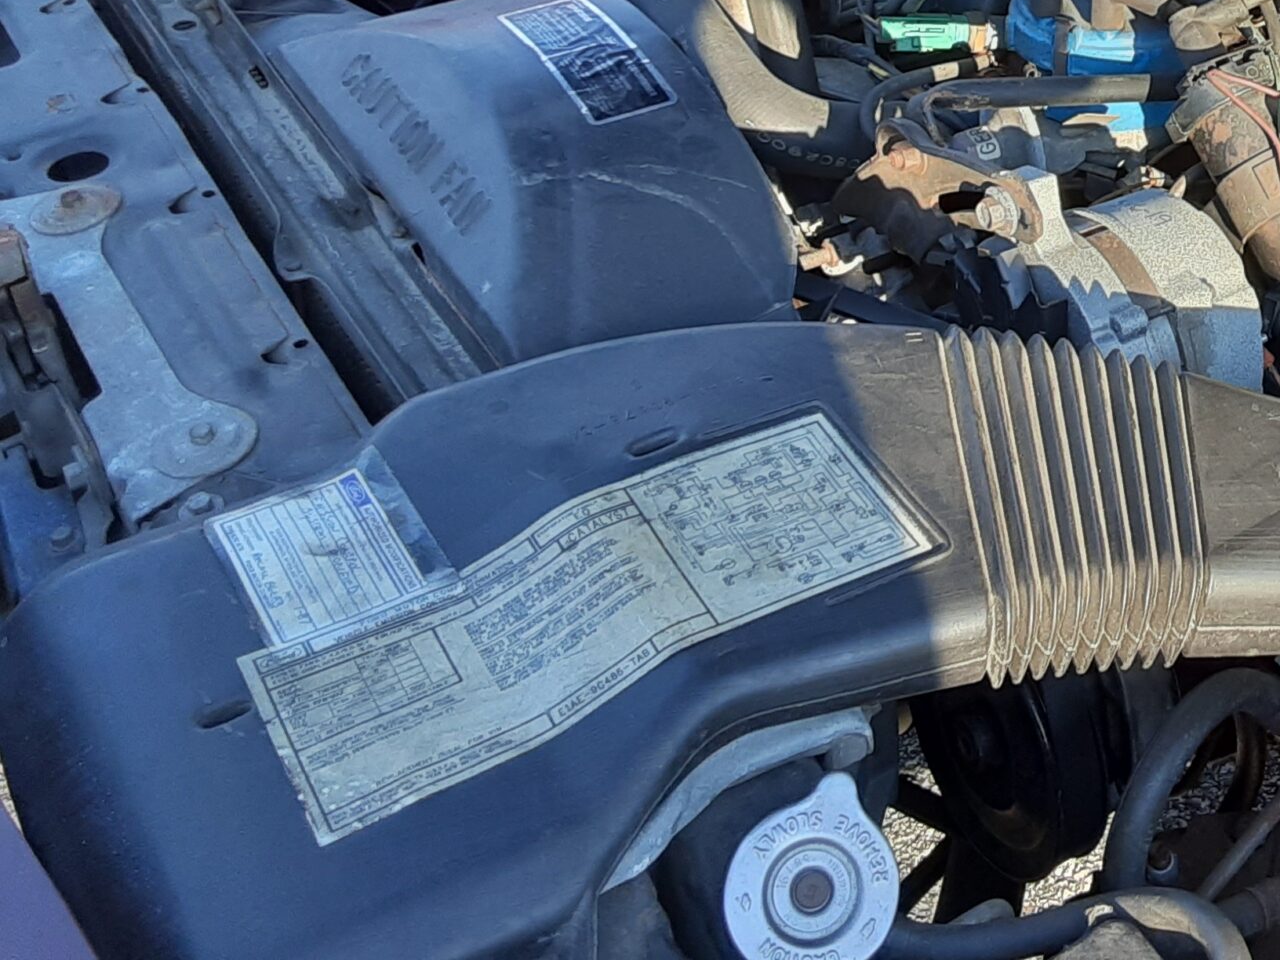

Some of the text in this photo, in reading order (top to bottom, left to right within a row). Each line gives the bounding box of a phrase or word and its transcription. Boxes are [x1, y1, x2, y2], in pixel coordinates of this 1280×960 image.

[341, 54, 494, 236] CAUTION FAN
[566, 507, 631, 542] CATALYST
[753, 809, 824, 861] SLOWLY
[833, 813, 889, 884] REMOVE
